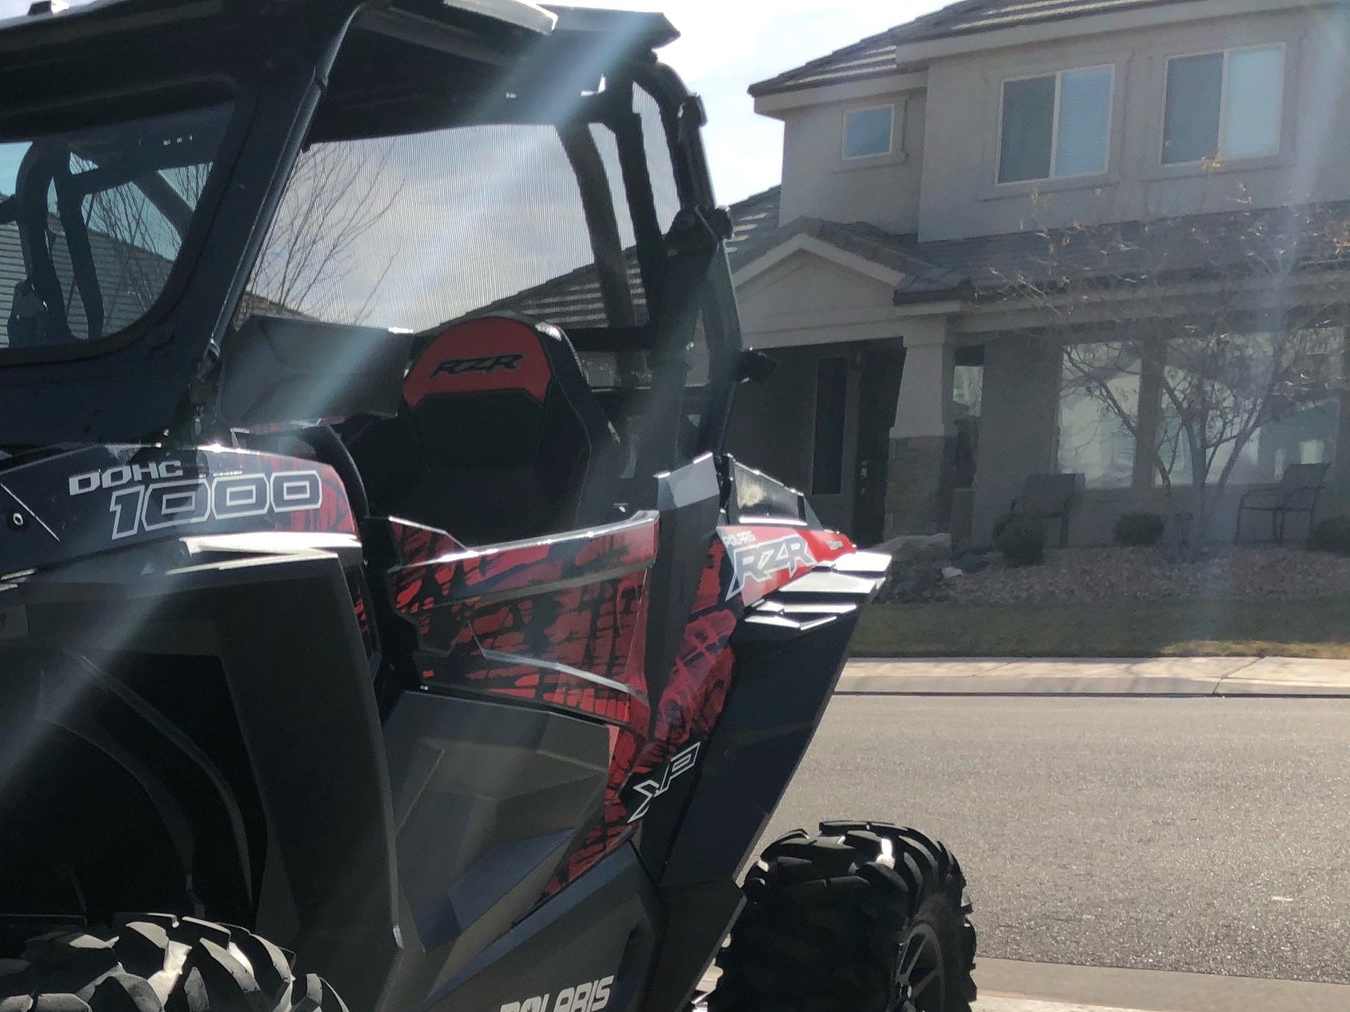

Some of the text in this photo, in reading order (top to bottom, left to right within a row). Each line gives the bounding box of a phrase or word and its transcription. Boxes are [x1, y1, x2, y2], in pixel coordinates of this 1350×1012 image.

[430, 354, 524, 378] RZR
[69, 461, 184, 496] DOHC
[110, 470, 323, 540] 1000
[725, 534, 818, 602] RZR
